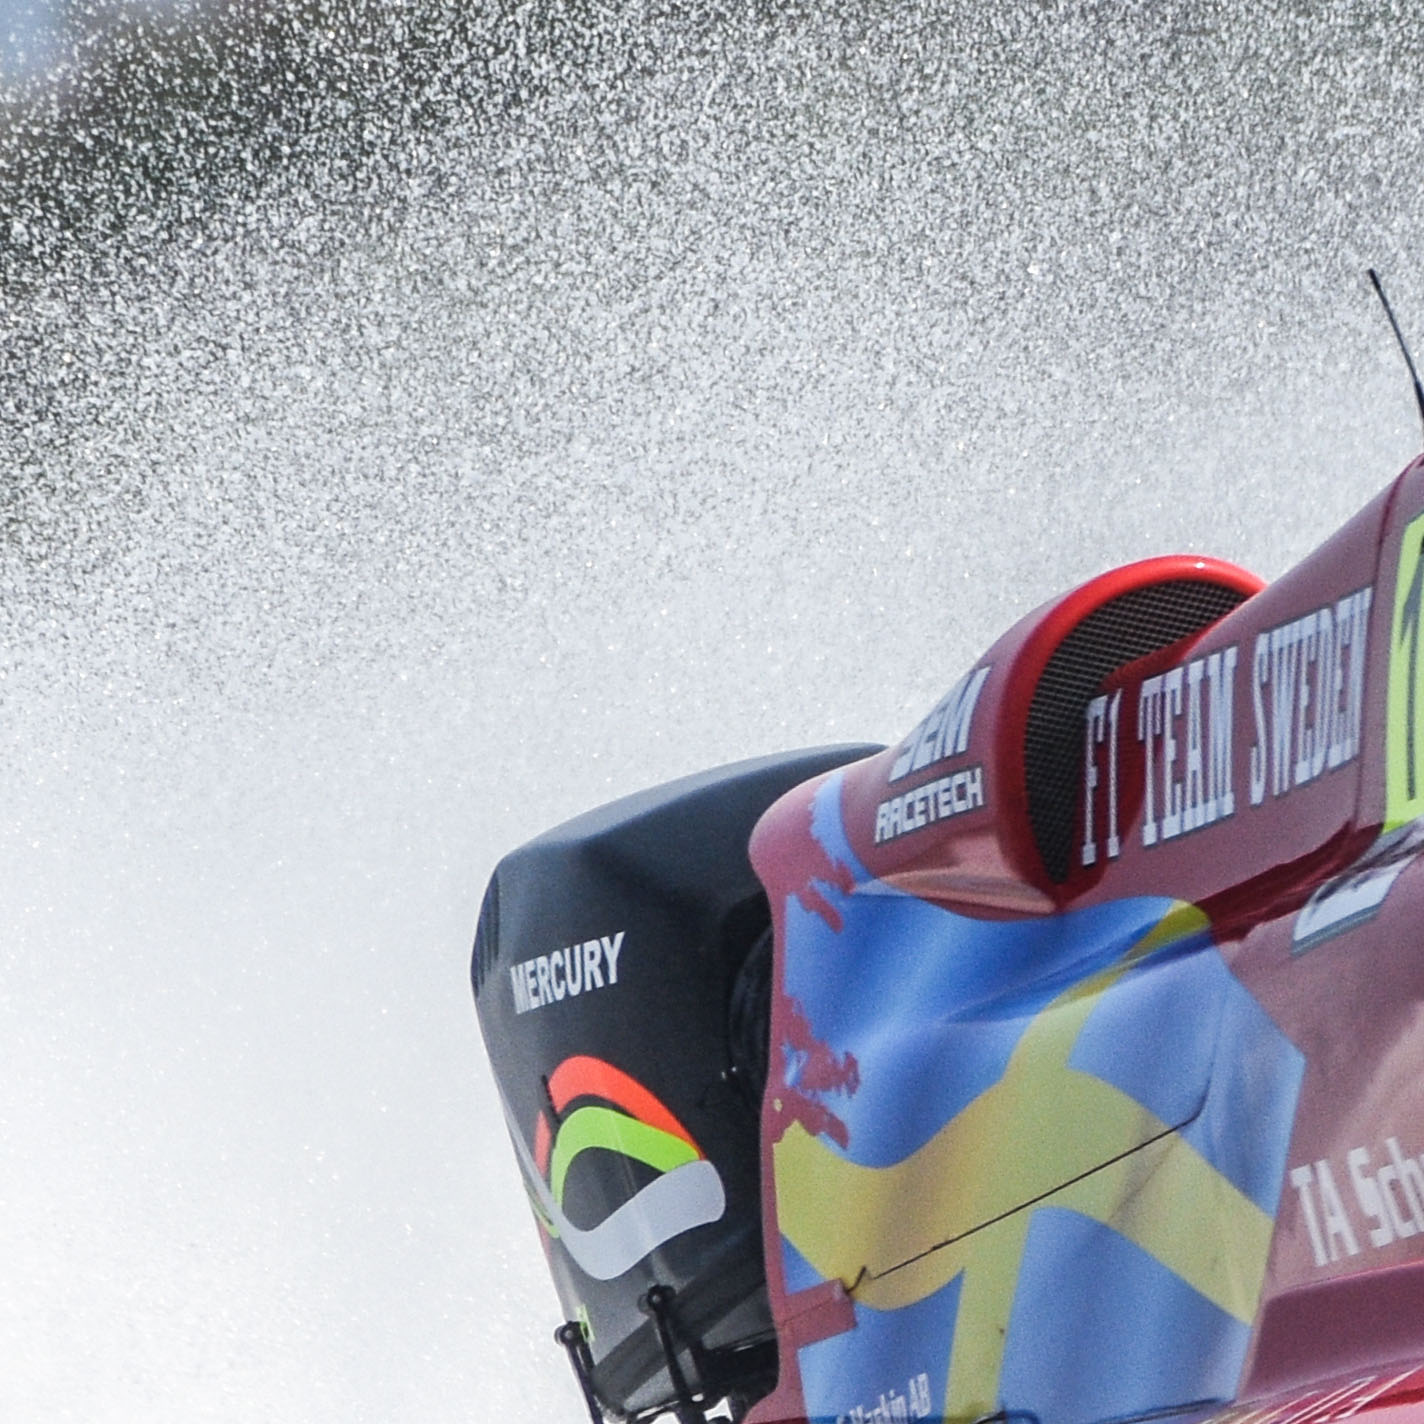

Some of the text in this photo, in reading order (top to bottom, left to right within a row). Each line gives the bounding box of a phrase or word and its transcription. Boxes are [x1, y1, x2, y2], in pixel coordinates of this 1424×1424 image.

[1082, 587, 1373, 866] F1 TEAM SWEDEN
[875, 766, 985, 844] RACETECH
[510, 931, 626, 1015] MERCURY
[1291, 1159, 1361, 1267] TA
[909, 1372, 932, 1419] AB
